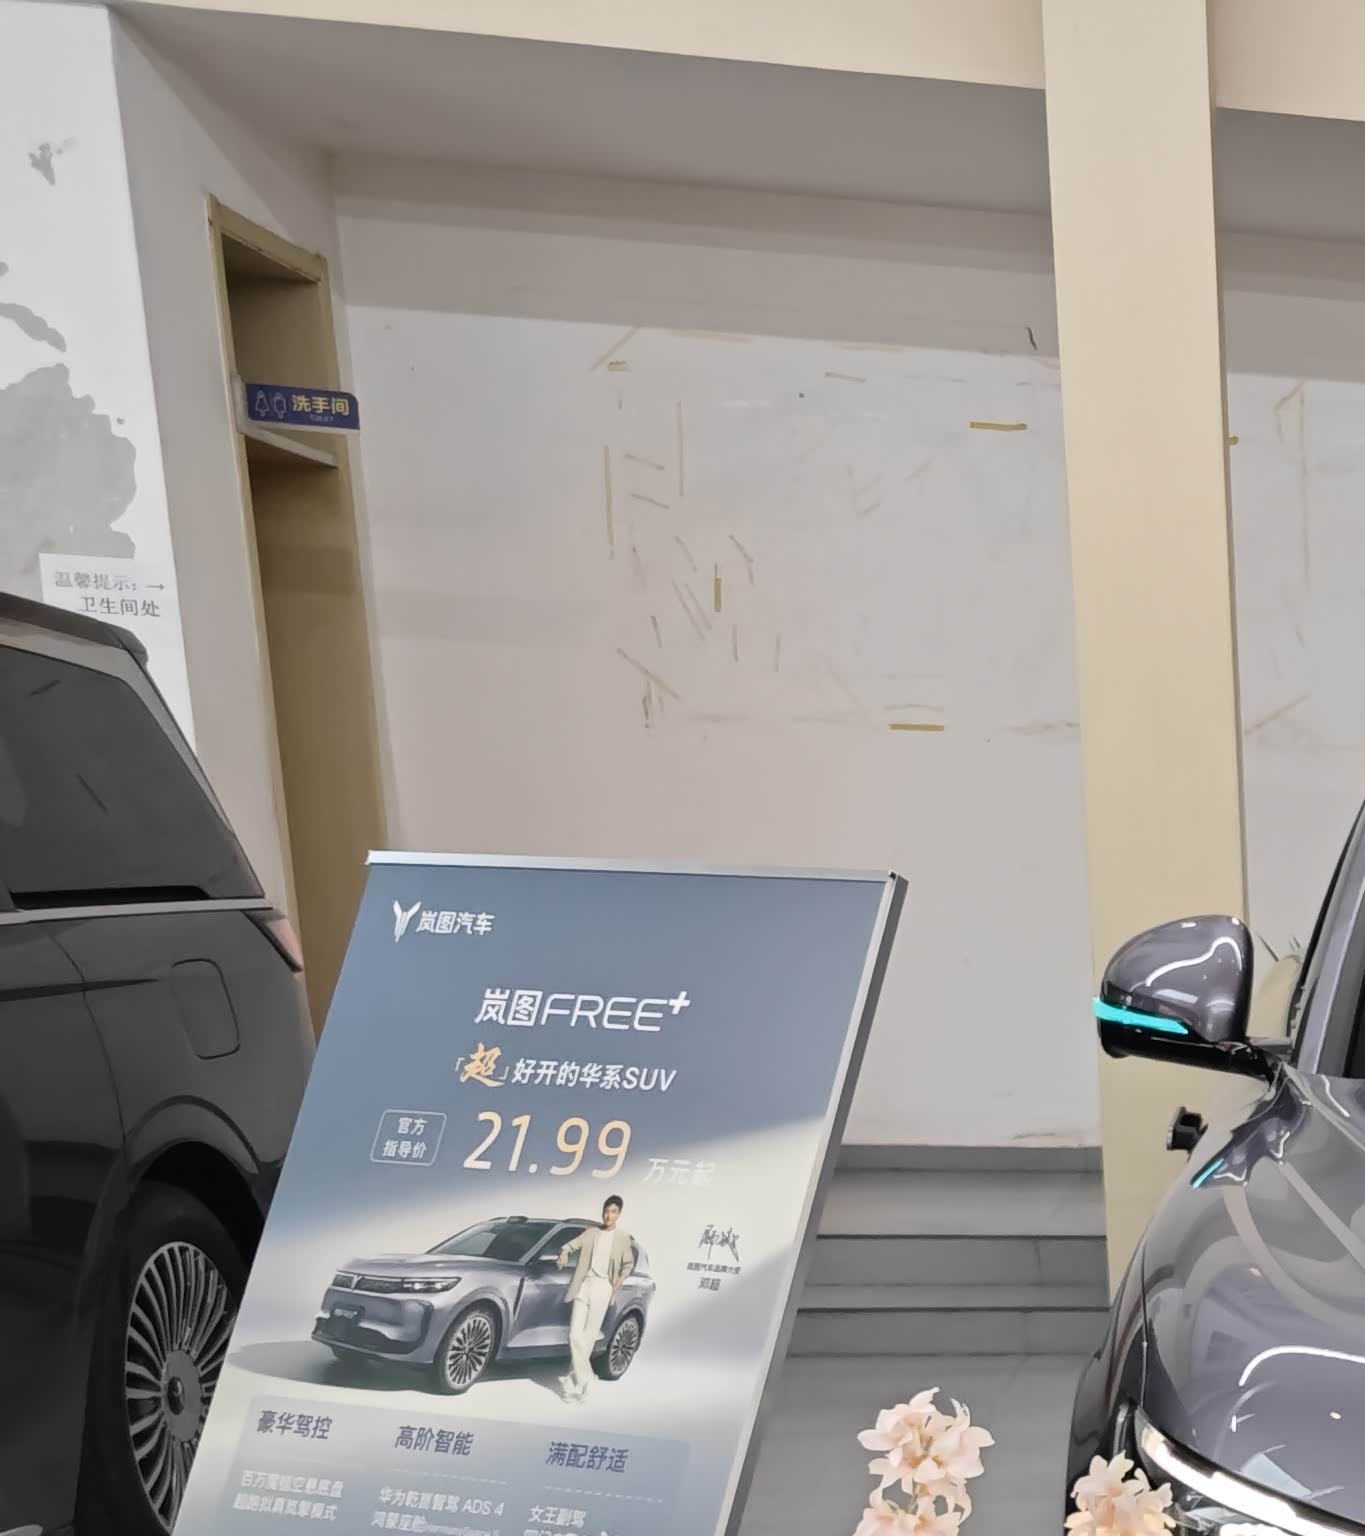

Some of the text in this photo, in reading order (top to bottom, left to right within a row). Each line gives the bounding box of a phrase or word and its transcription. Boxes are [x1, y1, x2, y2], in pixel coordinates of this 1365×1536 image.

[291, 394, 350, 416] 洗手间
[54, 571, 137, 592] 温馨提示：
[79, 597, 161, 617] 卫生间处
[416, 910, 495, 936] 岚图汽车
[475, 987, 691, 1032] 岚图FREE+
[397, 1117, 428, 1136] 官方
[382, 1138, 428, 1160] 指导价
[462, 1110, 634, 1180] 21.99
[256, 1409, 333, 1441] 豪华驾控
[394, 1424, 475, 1457] 高阶智能
[545, 1440, 629, 1474] 满配舒适
[462, 1499, 492, 1517] ADS
[493, 1500, 505, 1518] 4
